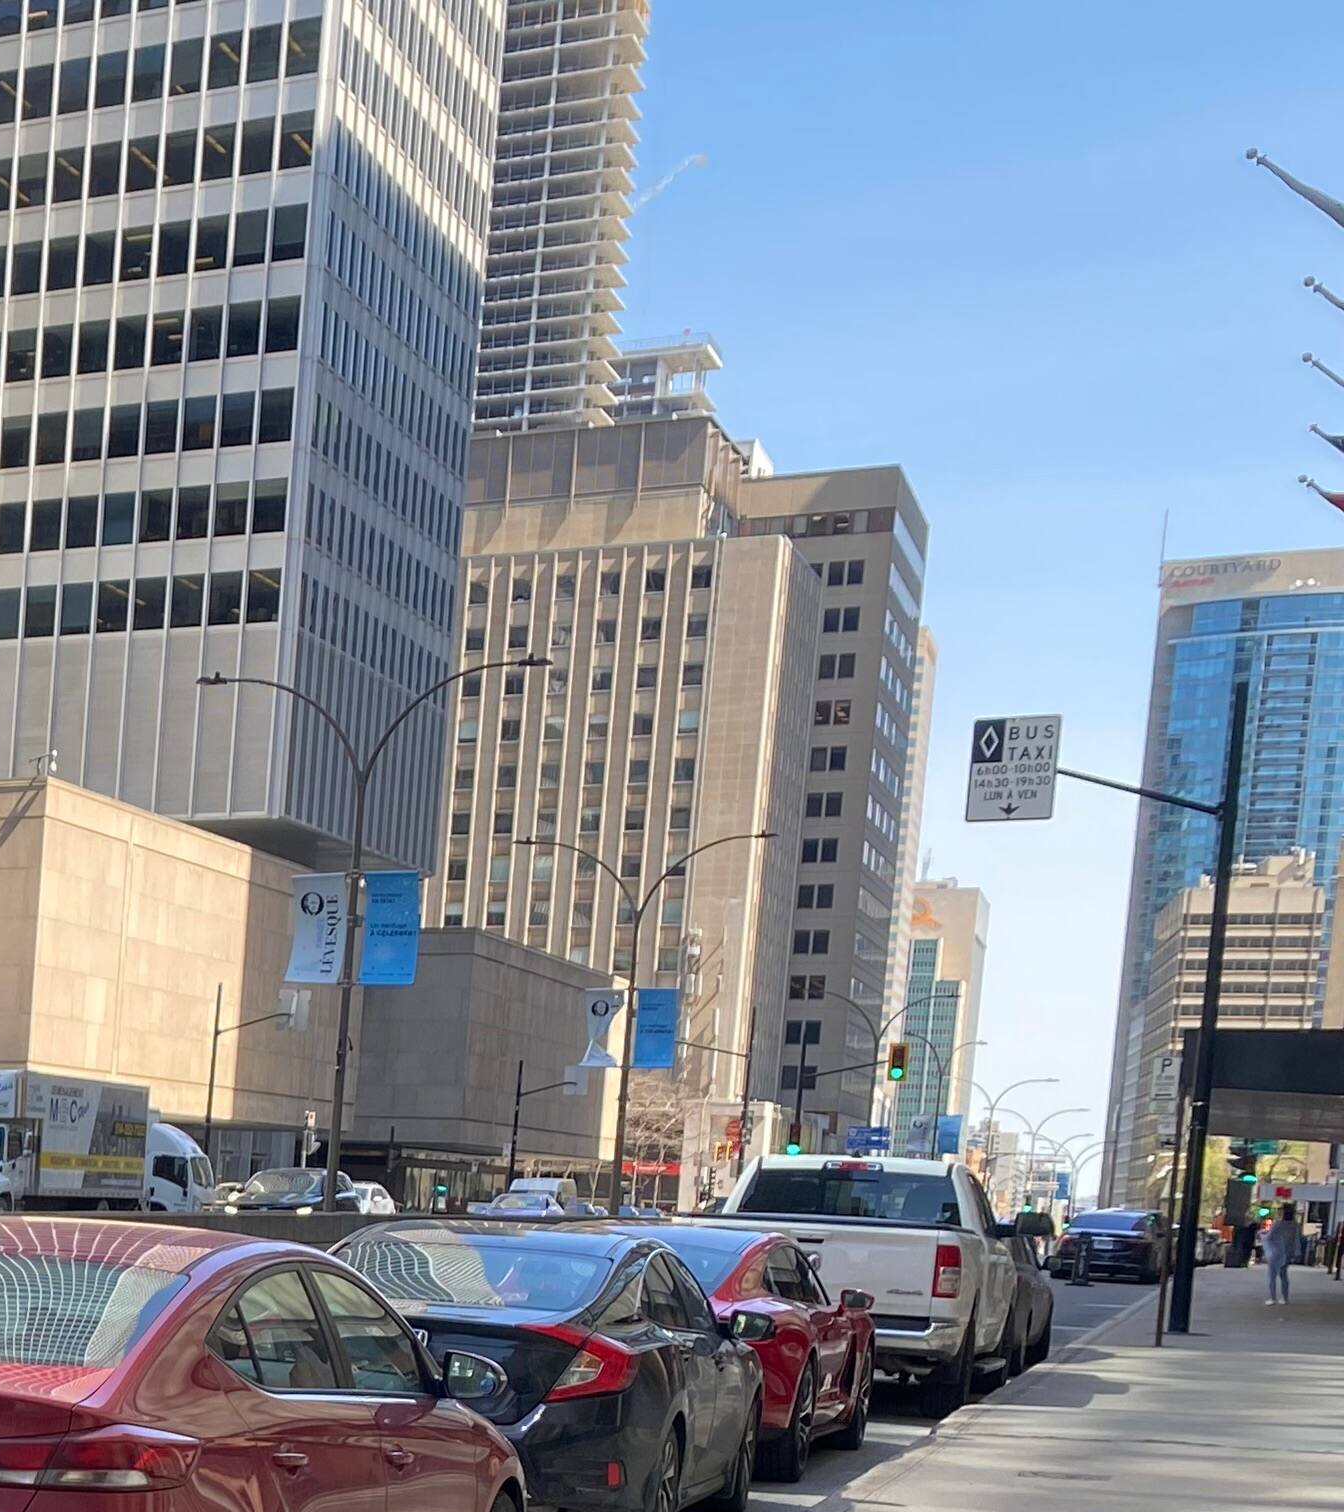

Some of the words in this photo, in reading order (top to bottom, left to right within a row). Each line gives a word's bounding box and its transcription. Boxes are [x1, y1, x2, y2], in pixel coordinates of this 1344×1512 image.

[1169, 558, 1281, 578] COURTYARD
[1009, 724, 1054, 741] BUS
[1008, 745, 1053, 761] TAXI
[984, 790, 1003, 801] LUN
[1017, 789, 1038, 800] VEN
[320, 894, 342, 974] LÉVESQUE
